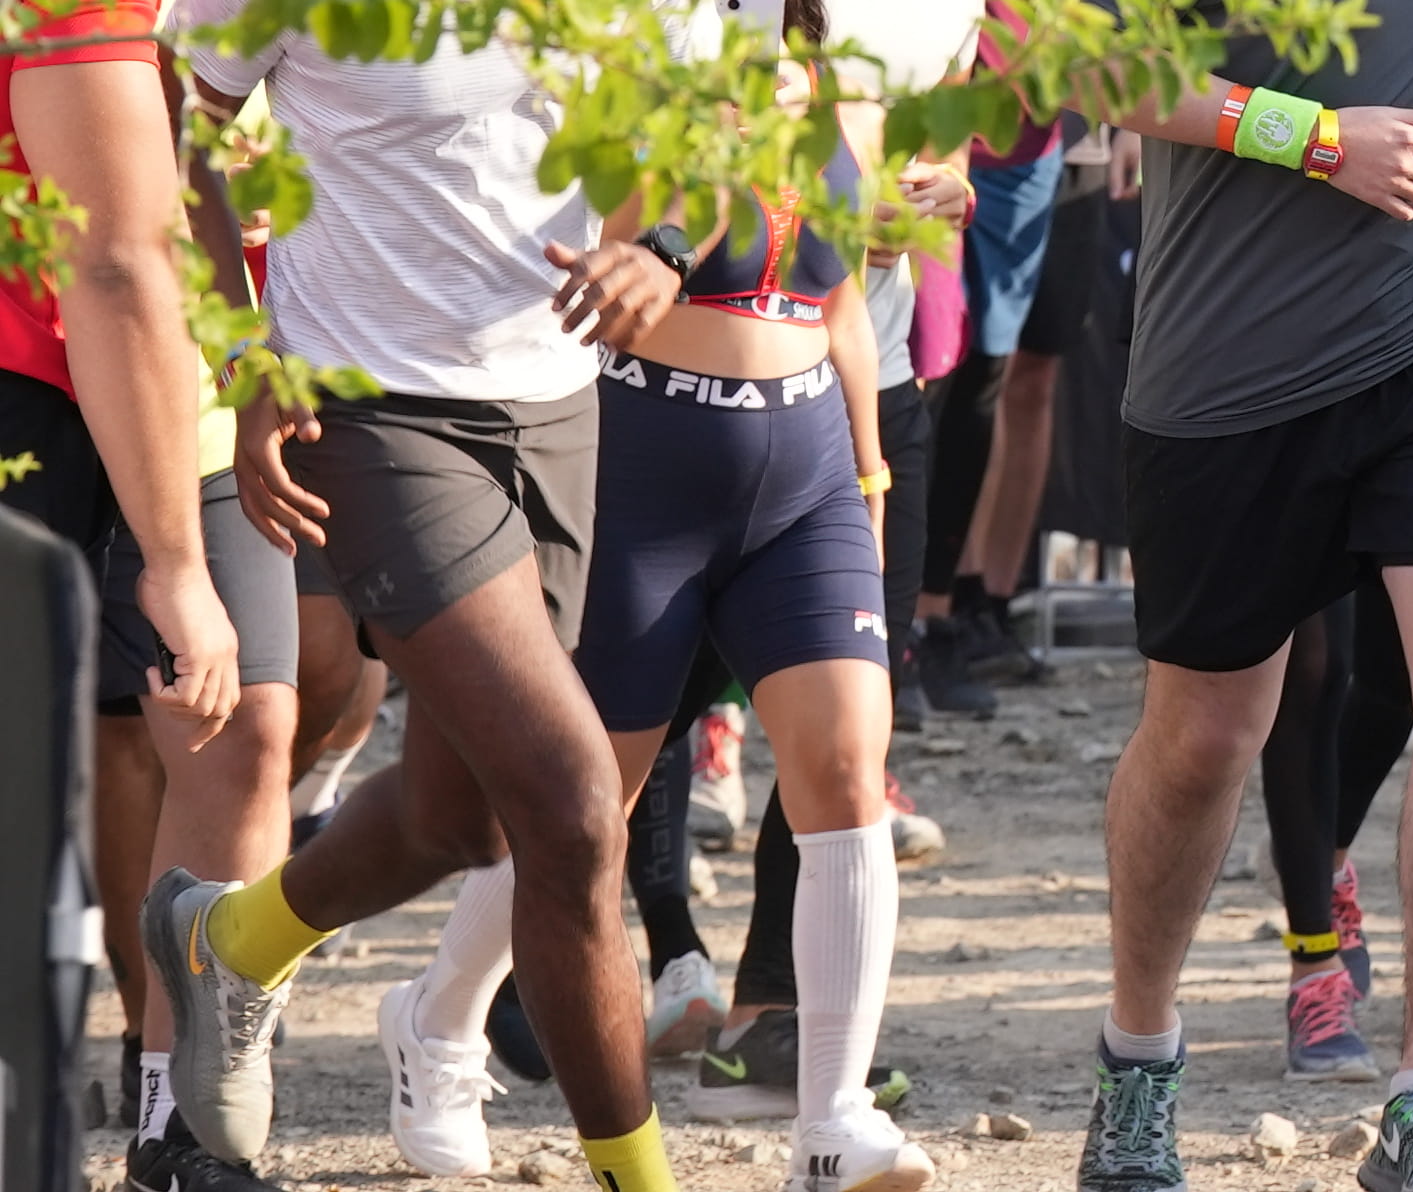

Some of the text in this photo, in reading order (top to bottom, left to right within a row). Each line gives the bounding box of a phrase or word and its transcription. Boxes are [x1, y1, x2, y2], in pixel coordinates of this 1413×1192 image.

[600, 341, 834, 409] ILA FILA FILA
